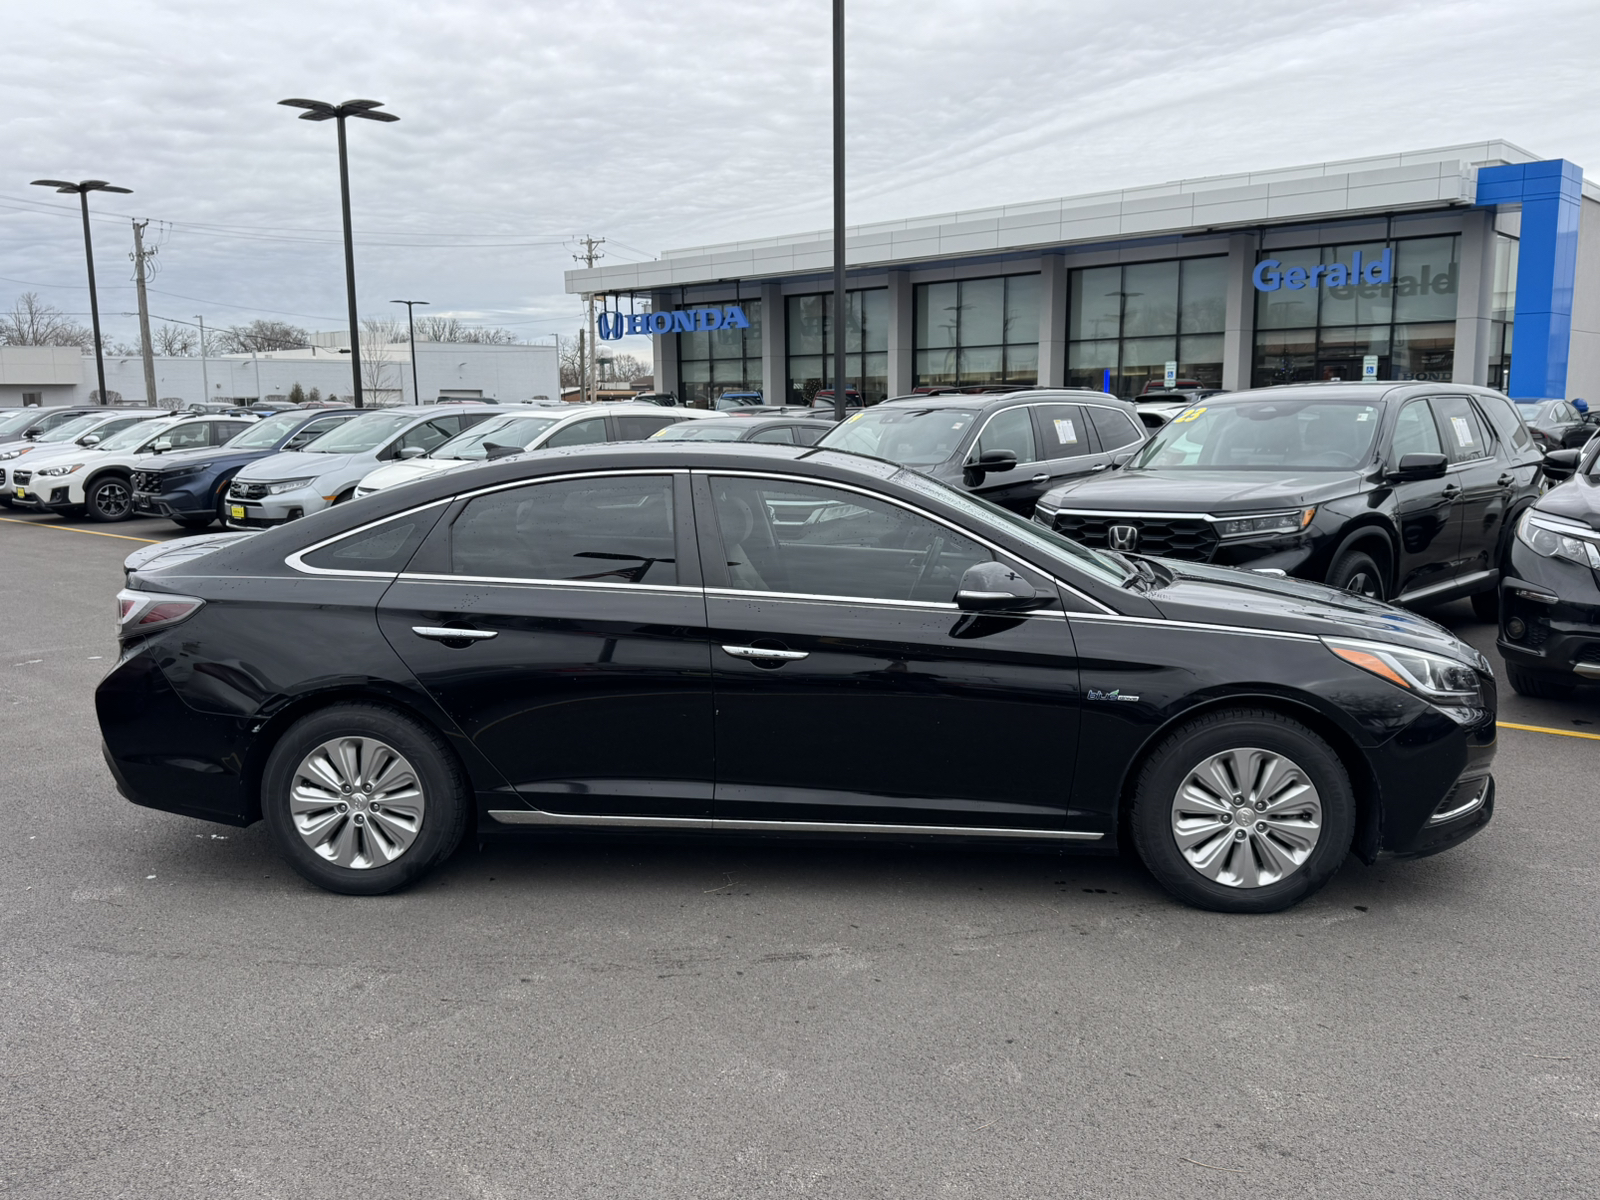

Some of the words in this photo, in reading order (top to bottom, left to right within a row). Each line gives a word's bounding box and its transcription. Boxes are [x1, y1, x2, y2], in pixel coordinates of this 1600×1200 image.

[1253, 248, 1391, 292] Gerald
[624, 306, 750, 335] HONDA
[1402, 372, 1452, 380] HOND
[1174, 407, 1208, 424] 23
